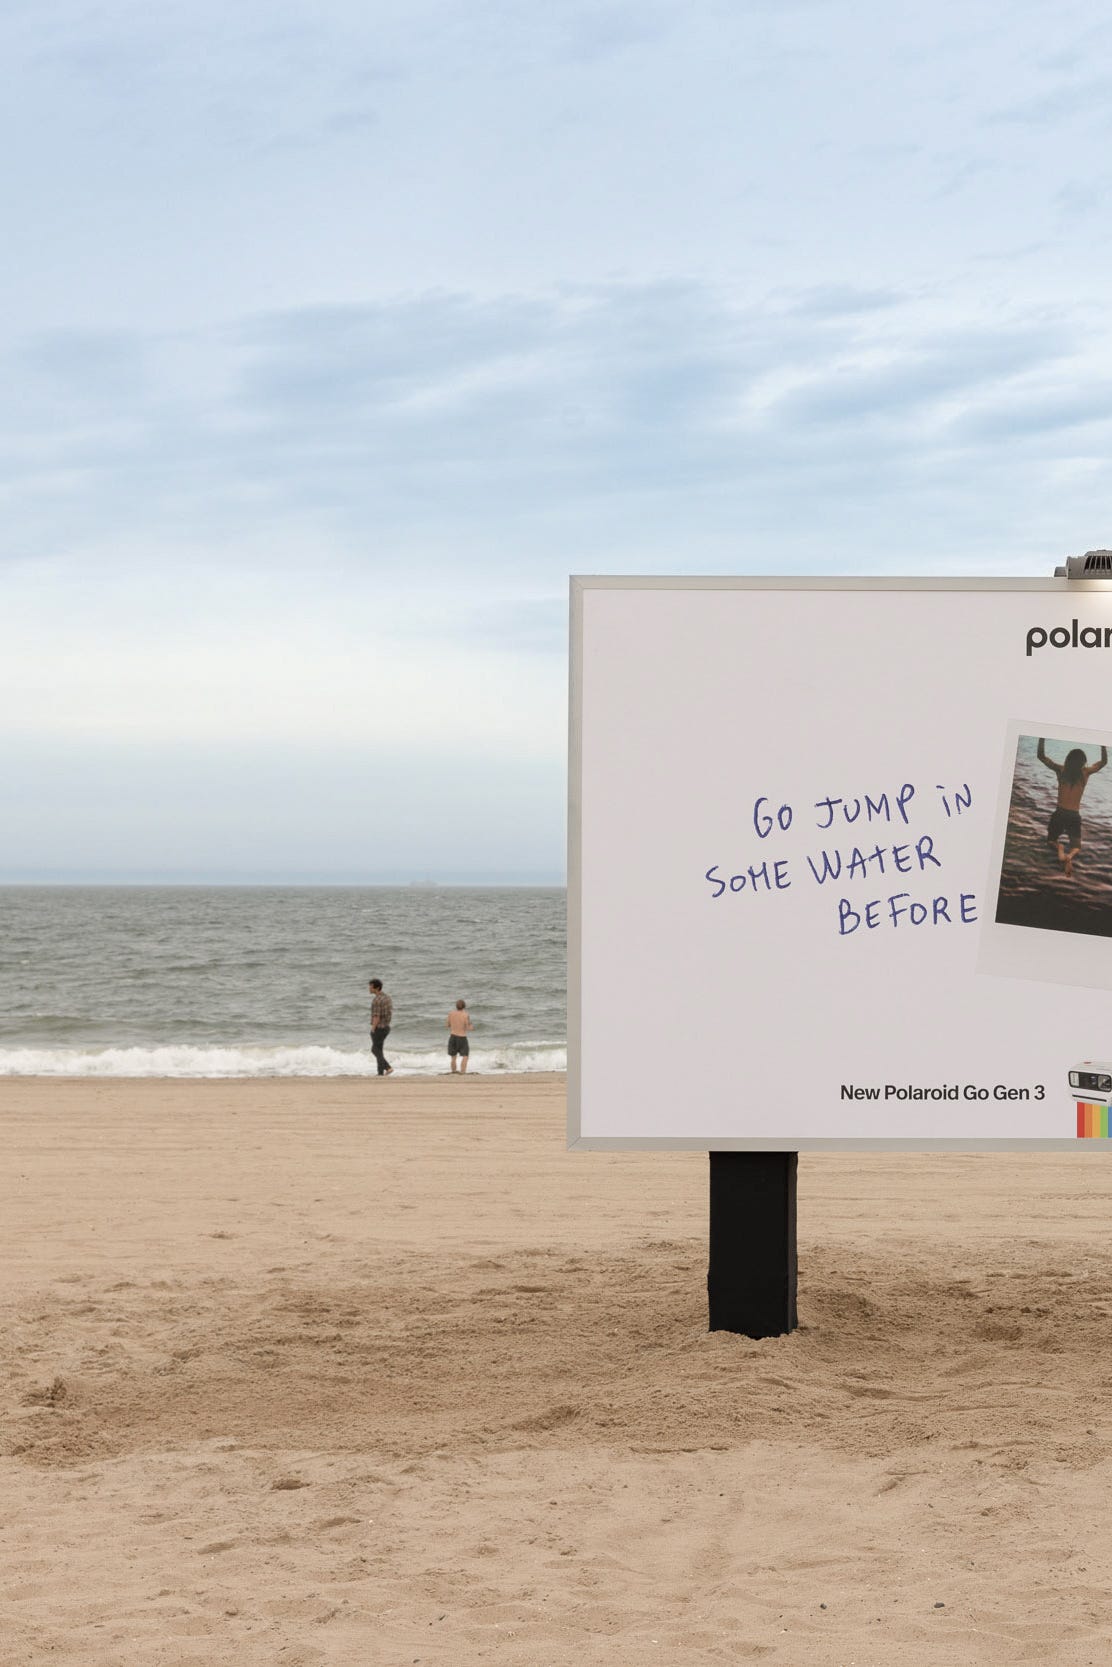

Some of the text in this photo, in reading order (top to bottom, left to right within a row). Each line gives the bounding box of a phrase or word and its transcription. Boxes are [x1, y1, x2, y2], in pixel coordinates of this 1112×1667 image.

[753, 796, 794, 839] GO
[814, 783, 915, 829] JUMP
[704, 835, 942, 899] SOME WATER
[838, 892, 978, 936] BEFORE
[840, 1084, 1046, 1101] New Polaroid Go Gen 3
